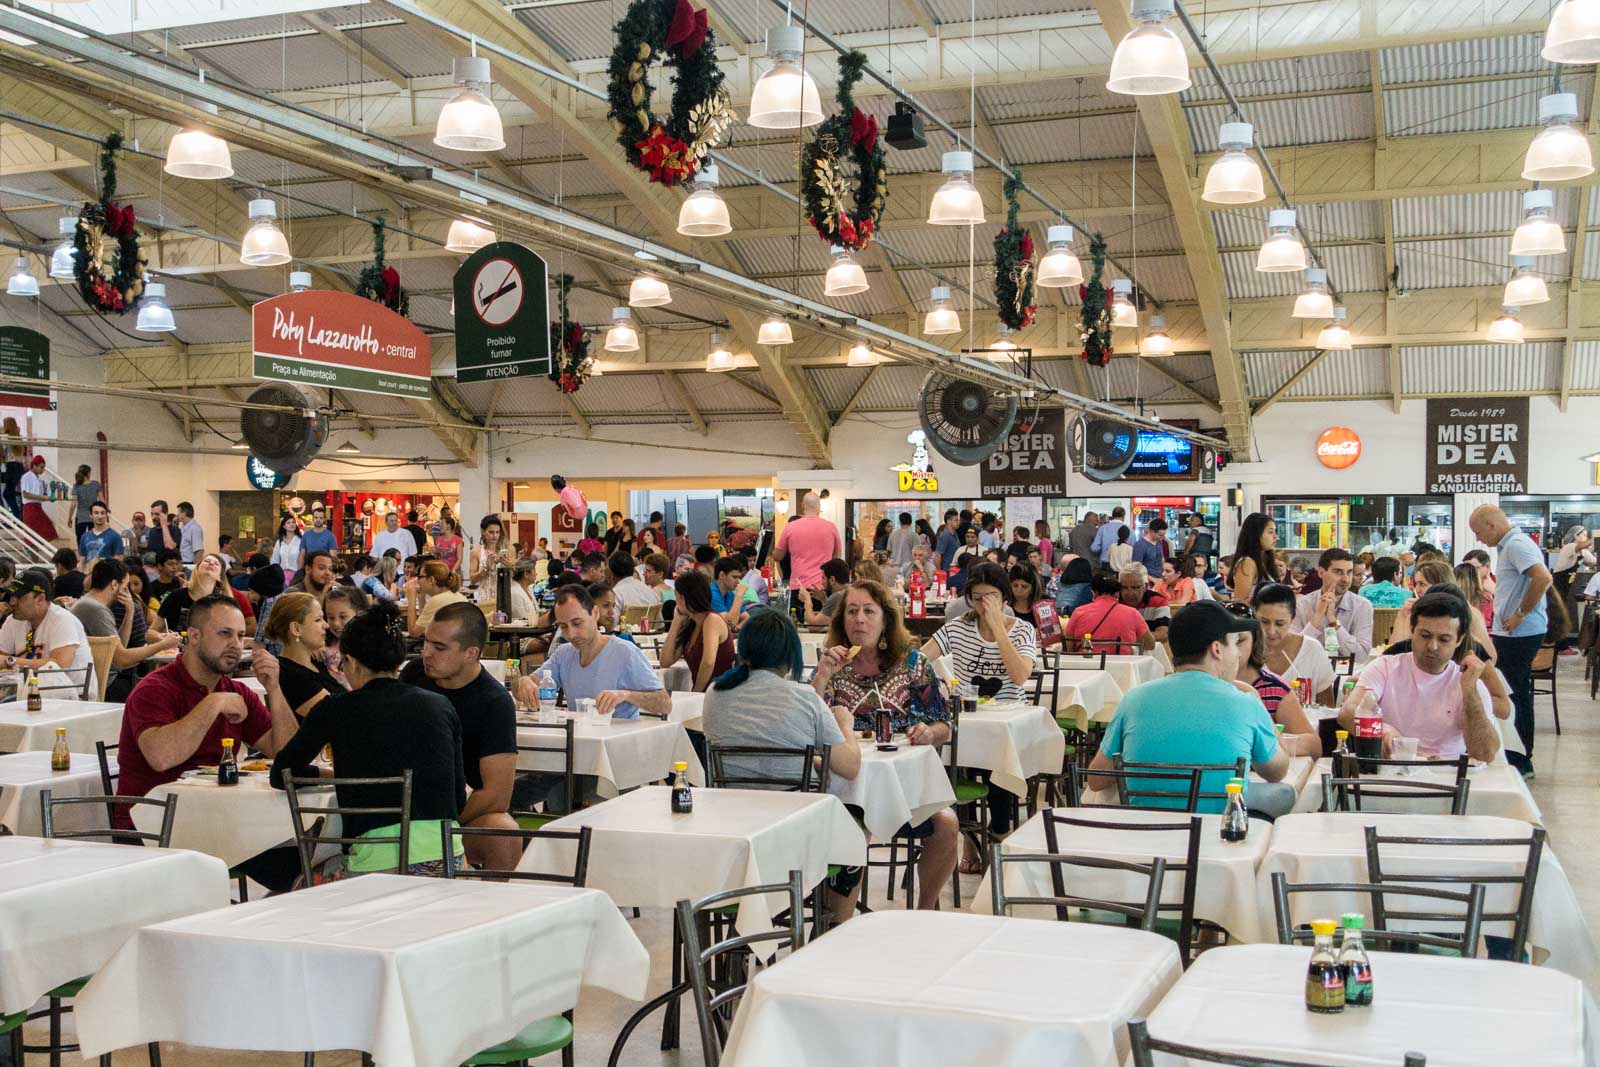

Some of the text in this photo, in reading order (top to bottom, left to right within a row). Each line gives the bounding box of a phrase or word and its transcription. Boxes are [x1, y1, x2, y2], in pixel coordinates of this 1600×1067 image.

[272, 307, 417, 359] Poty Lazzarotto central
[487, 336, 516, 346] Proibido
[491, 349, 512, 358] fumar
[272, 363, 291, 376] Praça
[299, 367, 337, 381] Alimentação
[486, 365, 519, 377] ATENÇÃO
[1449, 408, 1506, 417] Desde 1989
[1438, 424, 1518, 443] MISTER
[999, 433, 1055, 451] ISTER
[989, 451, 1055, 470] DEA
[1437, 444, 1517, 465] DEA
[898, 471, 938, 491] Dea
[912, 471, 935, 479] Mister
[1438, 474, 1516, 483] PASTELARIA
[983, 484, 1062, 495] BUFFET GRILL
[1430, 483, 1524, 493] SANDUICHERIA
